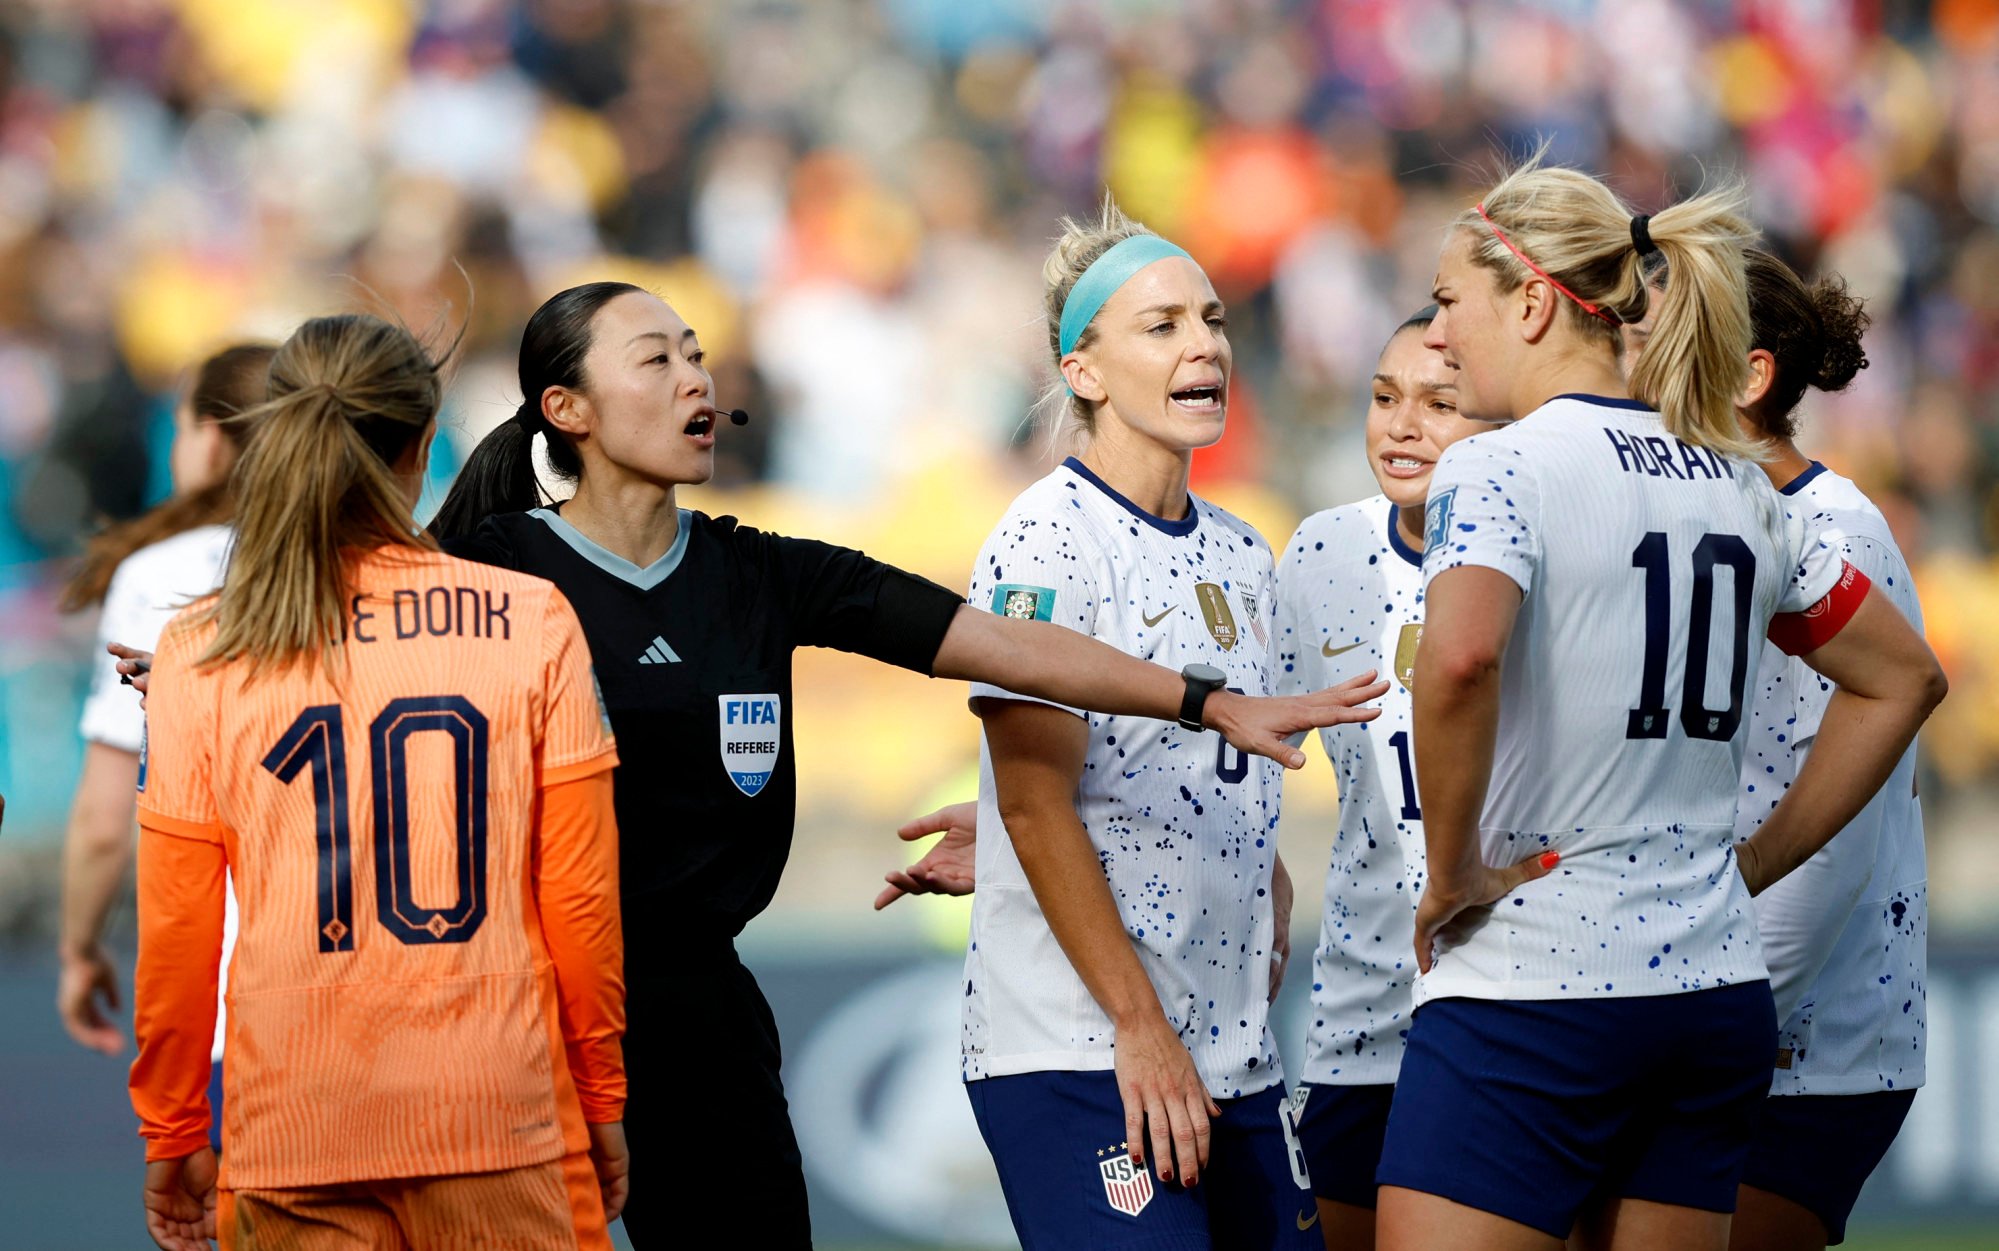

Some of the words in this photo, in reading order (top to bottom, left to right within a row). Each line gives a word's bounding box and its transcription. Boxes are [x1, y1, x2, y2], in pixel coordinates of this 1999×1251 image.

[1603, 427, 1734, 480] HORAN
[393, 586, 510, 641] DONK
[1214, 625, 1230, 634] FIFA
[1627, 532, 1757, 741] 10
[726, 701, 776, 725] FIFA
[727, 742, 775, 754] REFEREE
[741, 775, 763, 786] 2023
[261, 695, 490, 953] 10
